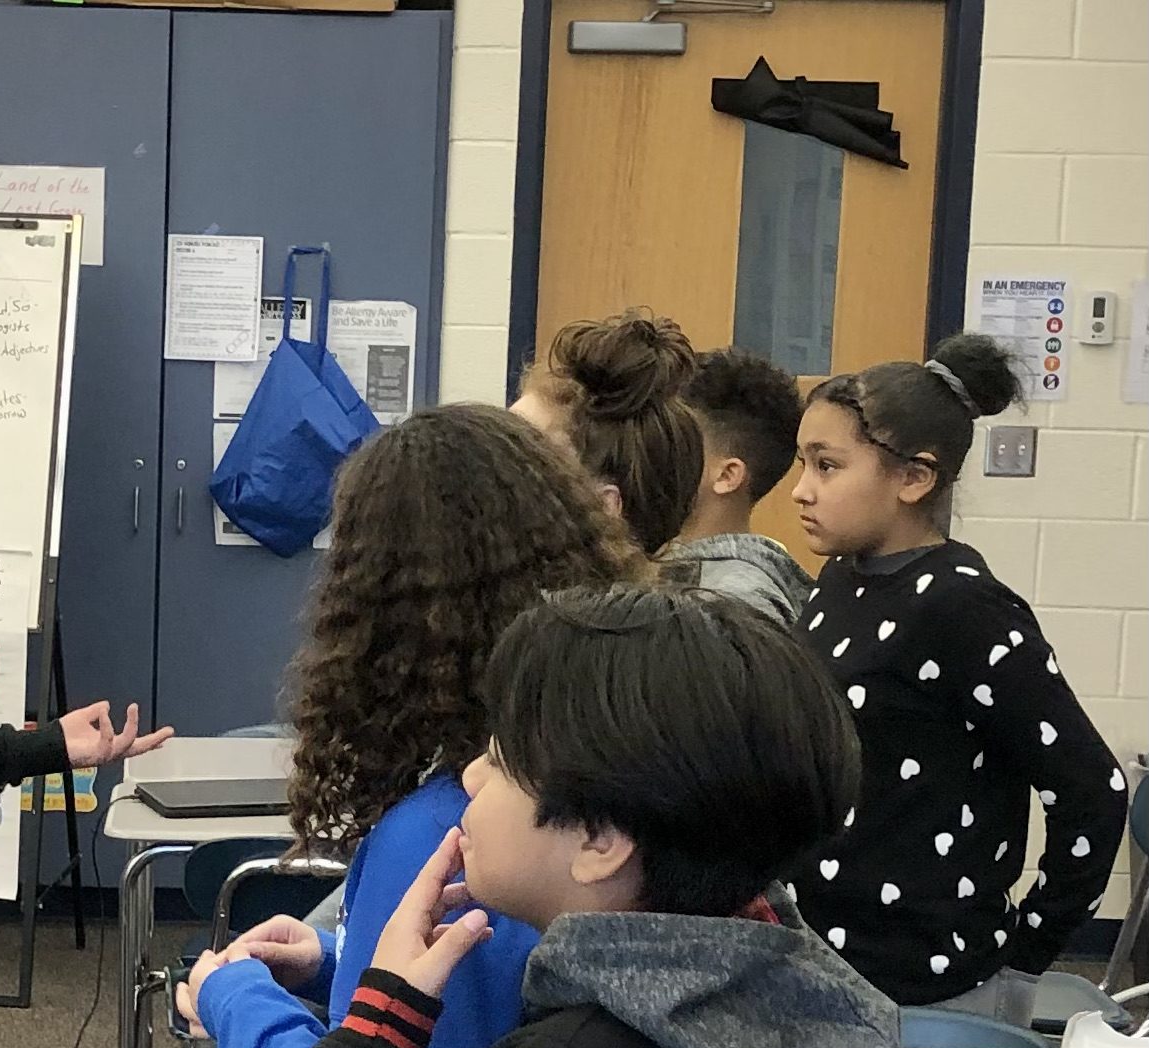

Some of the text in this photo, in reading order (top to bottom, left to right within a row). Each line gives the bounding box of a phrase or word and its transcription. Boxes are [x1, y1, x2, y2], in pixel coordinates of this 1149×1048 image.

[47, 177, 66, 193] of
[69, 176, 90, 194] the
[983, 280, 1066, 291] IN AN EMERGENCY
[331, 305, 408, 318] Be Allergy Aware
[331, 317, 398, 328] and Save a Life
